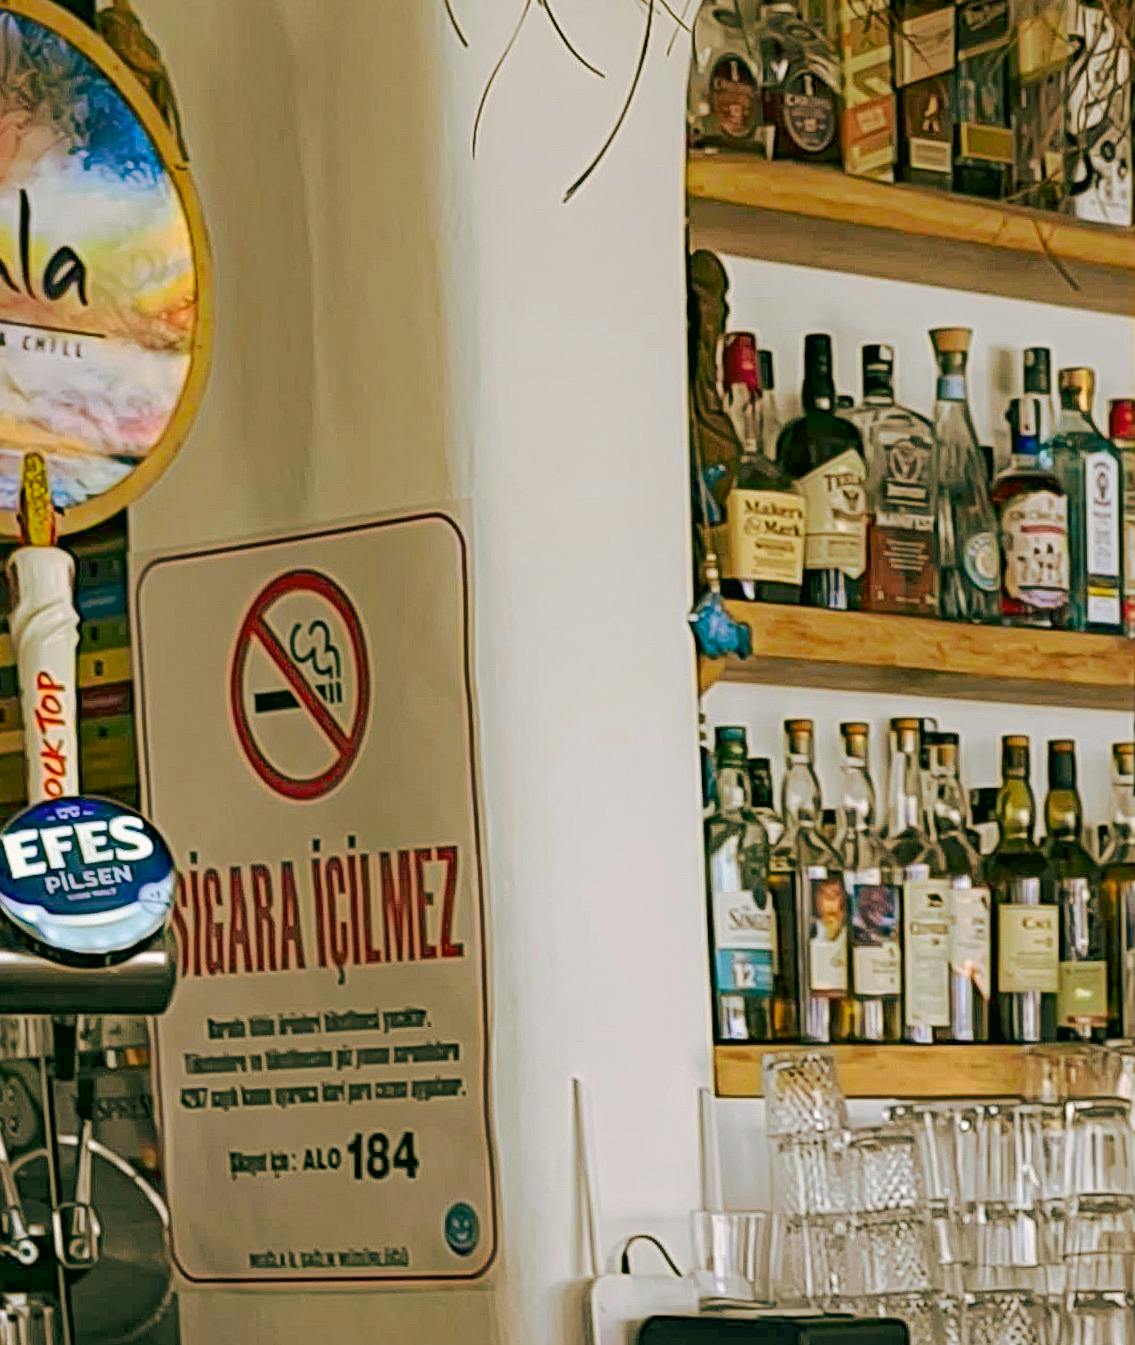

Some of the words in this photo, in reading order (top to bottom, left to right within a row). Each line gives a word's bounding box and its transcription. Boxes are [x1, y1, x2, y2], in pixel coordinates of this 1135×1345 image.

[0, 188, 88, 306] la
[2, 815, 154, 880] EFES
[311, 835, 464, 985] İÇİLMEZ
[303, 1148, 341, 1170] ALO
[347, 1132, 419, 1180] 184
